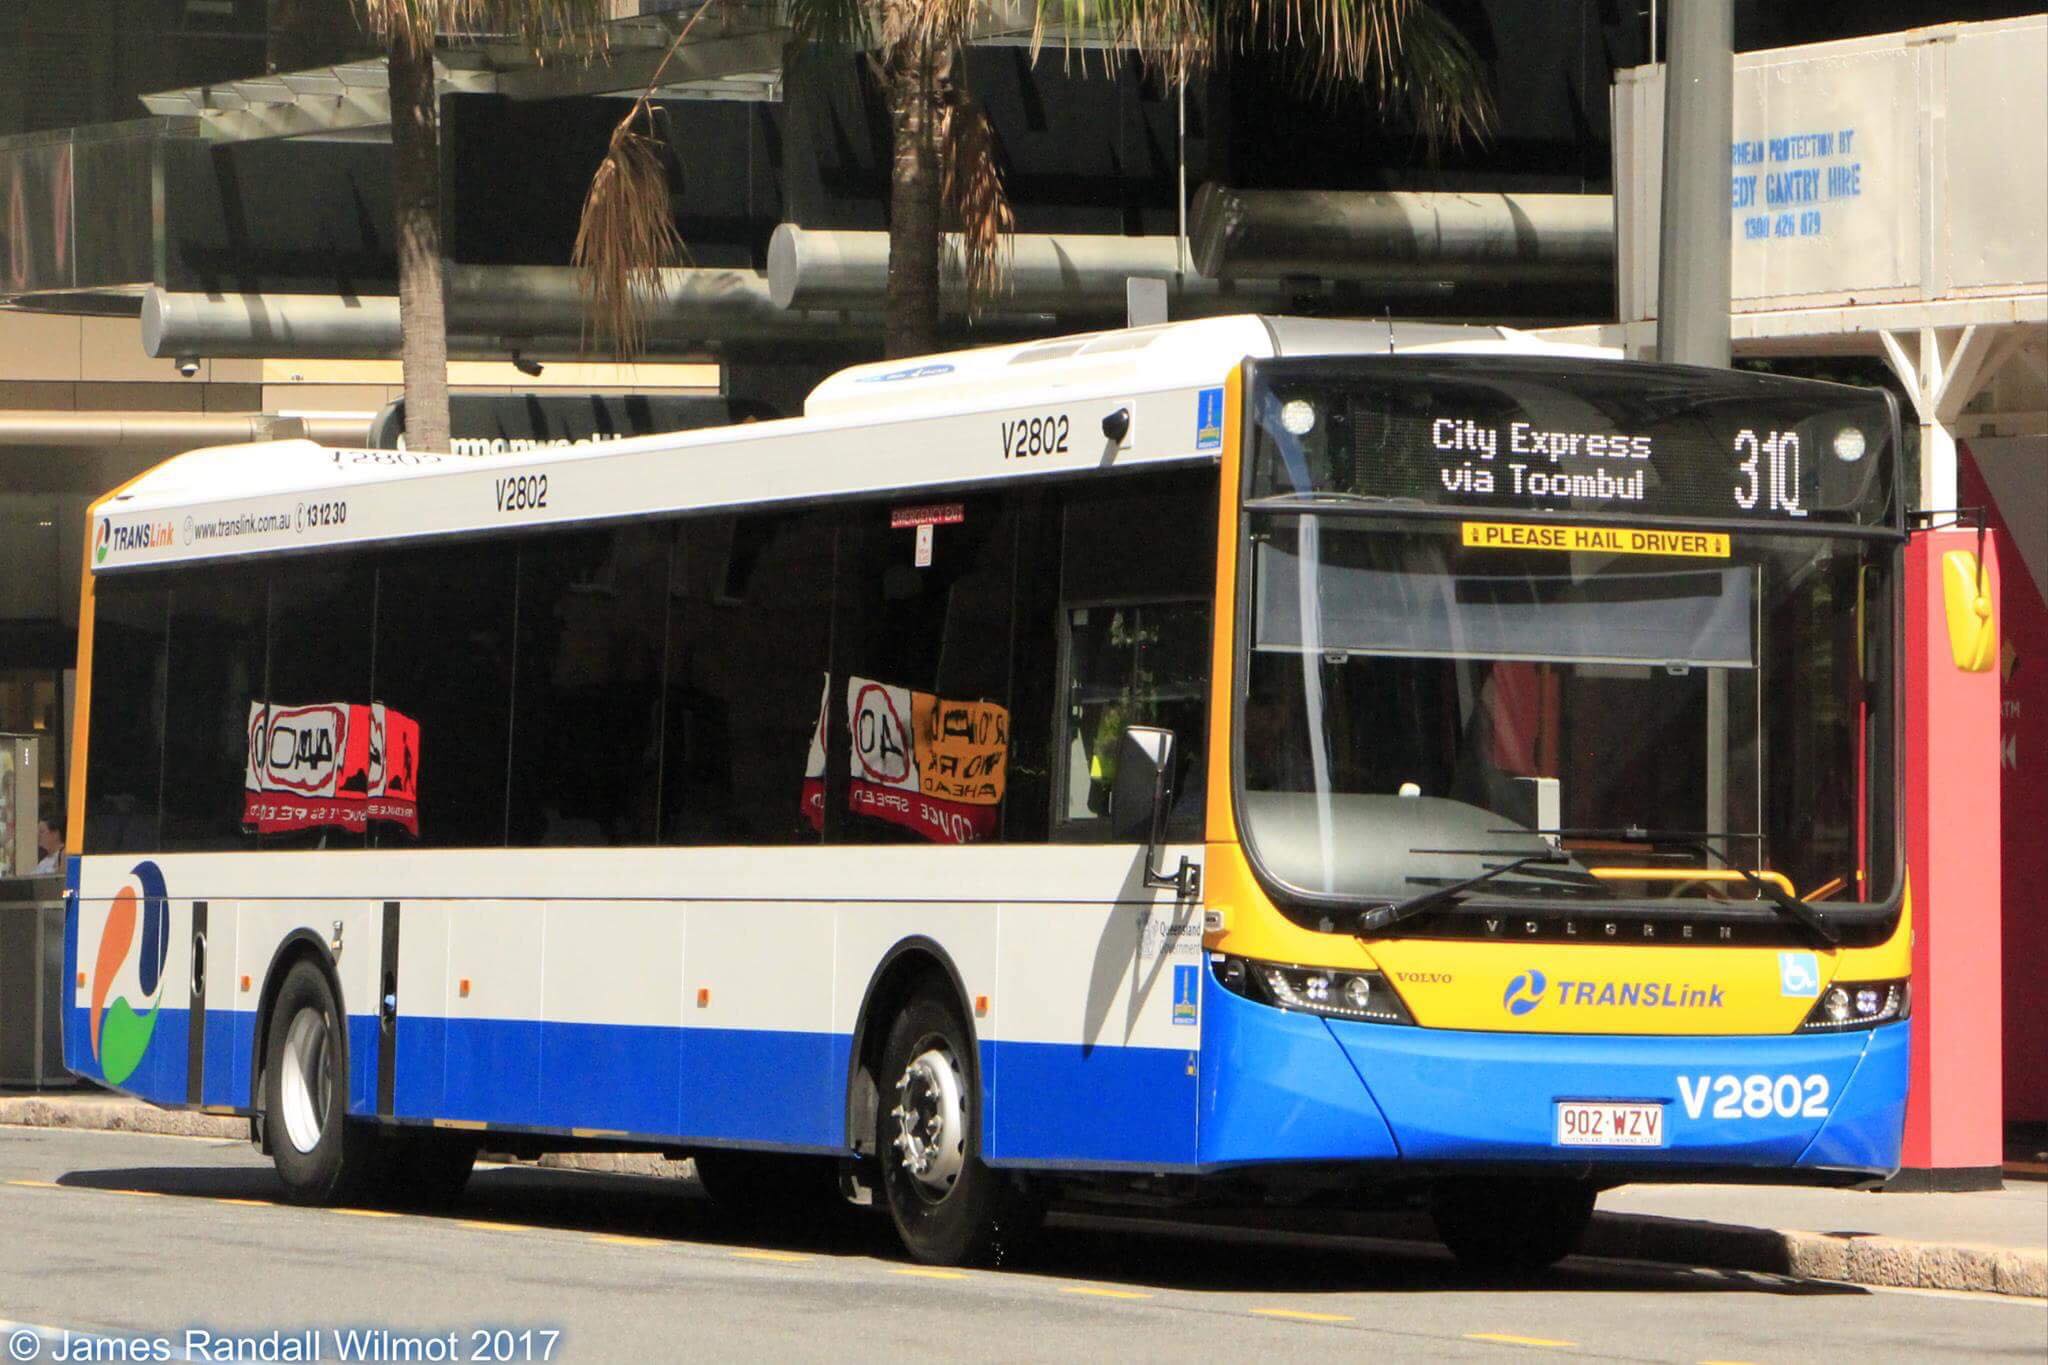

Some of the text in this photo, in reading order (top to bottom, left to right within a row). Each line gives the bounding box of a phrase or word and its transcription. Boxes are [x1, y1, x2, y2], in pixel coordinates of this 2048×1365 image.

[1731, 129, 1854, 166] RHEAD PROTECTION BY
[1731, 163, 1861, 208] EDY GANTRY HIRE
[1002, 414, 1069, 459] V2802
[1432, 418, 1652, 463] City Express
[1441, 461, 1644, 500] via Toombul
[1734, 429, 1800, 511] 310
[495, 474, 548, 512] V2802
[113, 521, 175, 551] TRANSLink
[194, 512, 290, 539] www.translink.com.au
[1486, 527, 1709, 553] PLEASE HAIL DRIVER
[1396, 971, 1452, 984] VOLVO
[1557, 981, 1726, 1009] TRANSLink
[1677, 1074, 1830, 1119] V2802
